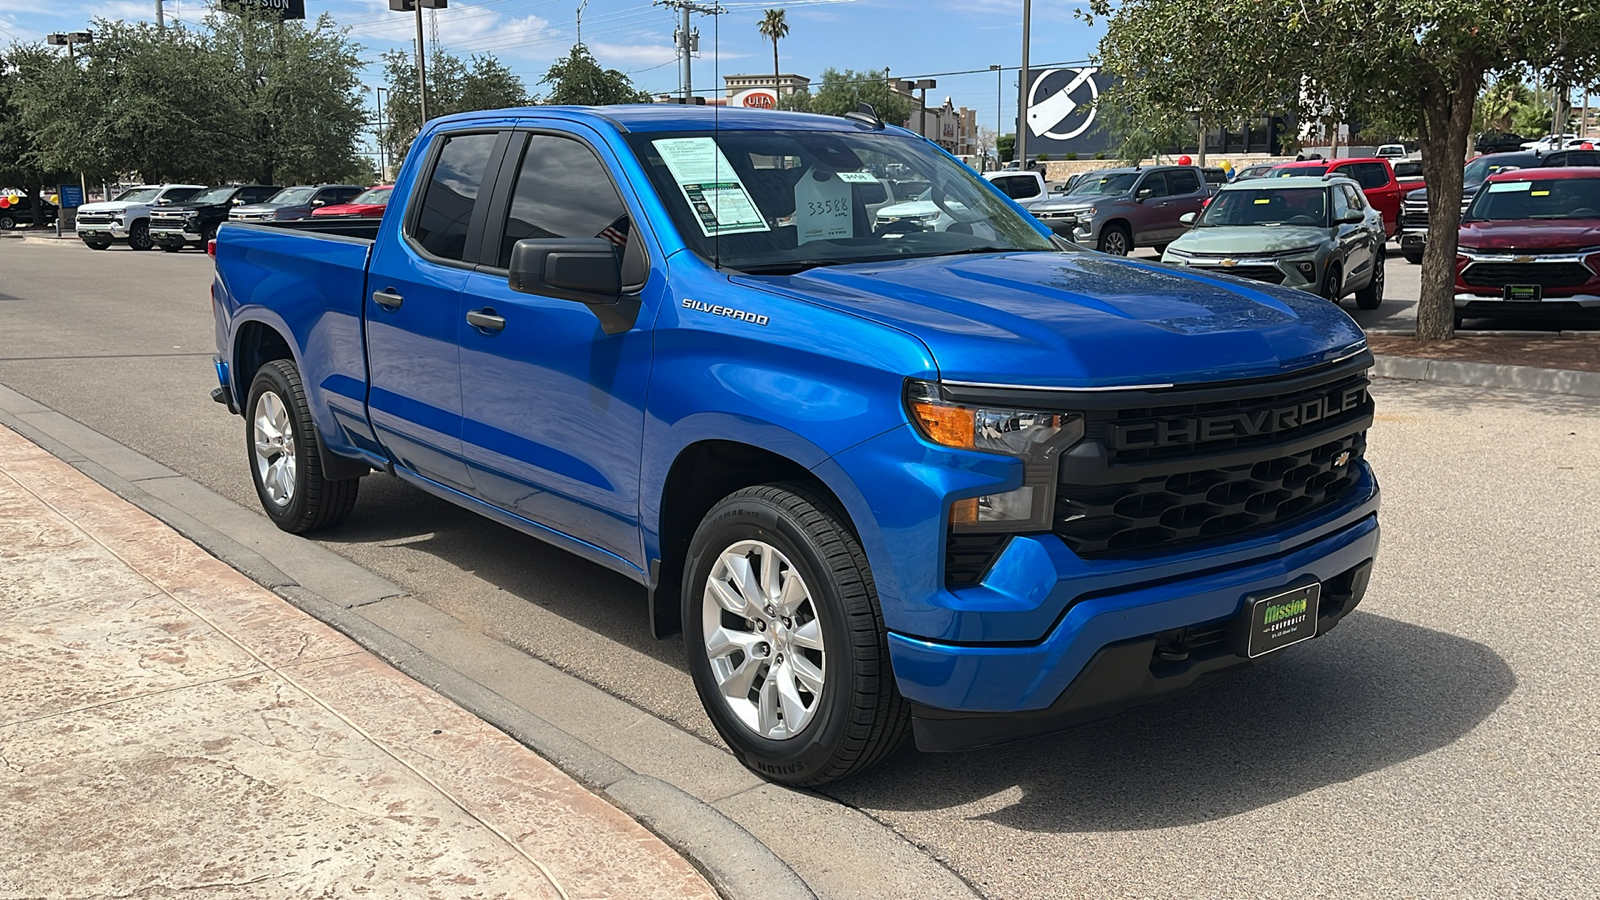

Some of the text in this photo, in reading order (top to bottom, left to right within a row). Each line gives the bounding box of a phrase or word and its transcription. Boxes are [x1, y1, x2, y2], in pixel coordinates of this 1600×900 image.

[239, 0, 289, 9] SION
[748, 96, 771, 105] ULTA
[807, 198, 848, 216] 33588
[681, 298, 769, 326] SILVERADO
[1110, 384, 1369, 450] CHEVROLET
[1264, 598, 1308, 625] Mission
[1271, 614, 1306, 631] CHEVROLET
[757, 761, 804, 774] SAILUN
